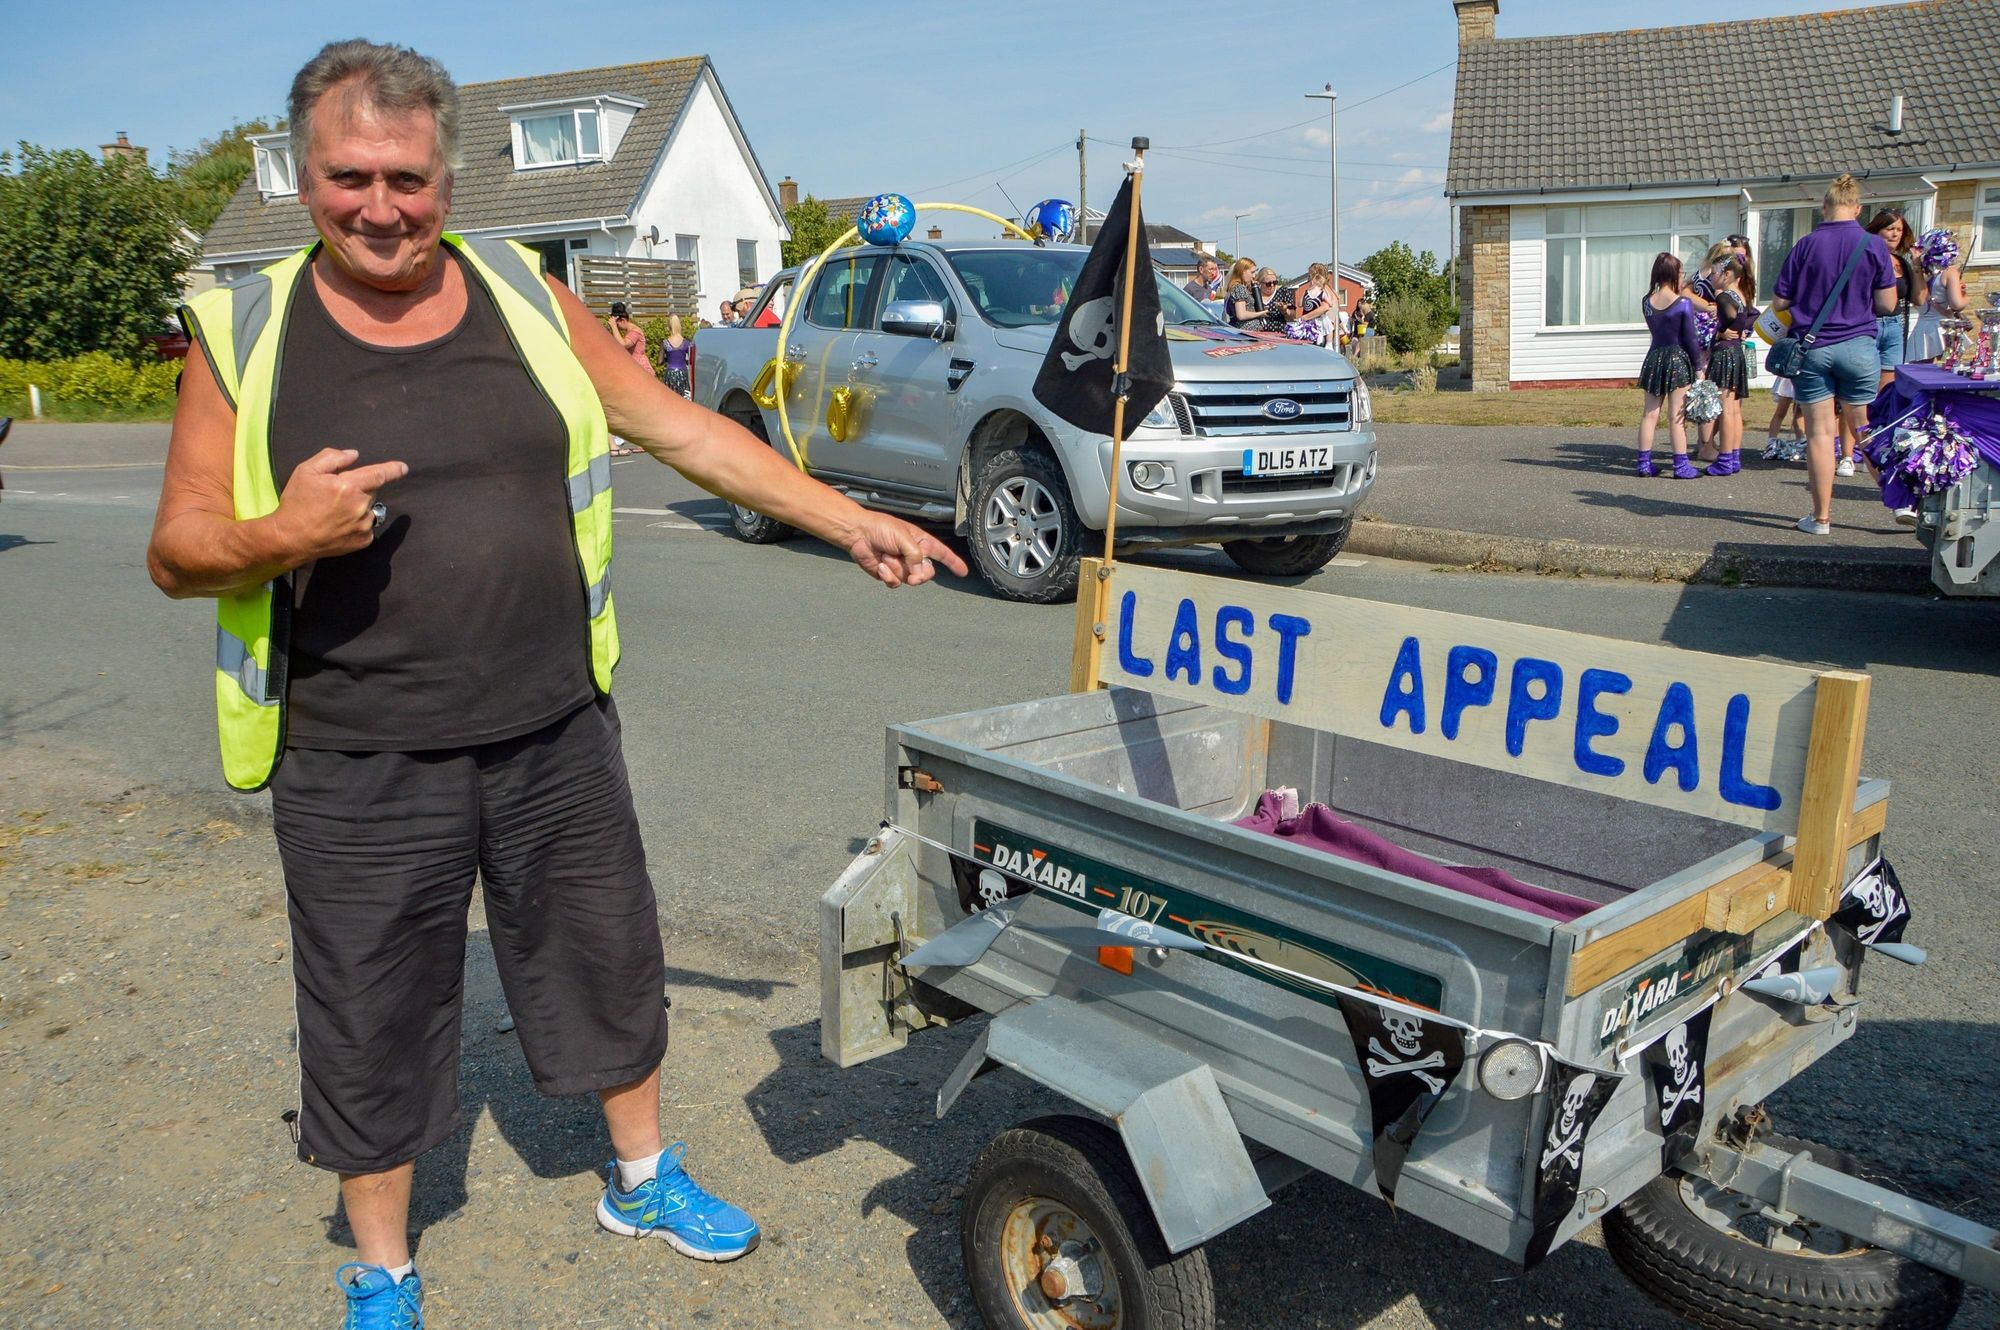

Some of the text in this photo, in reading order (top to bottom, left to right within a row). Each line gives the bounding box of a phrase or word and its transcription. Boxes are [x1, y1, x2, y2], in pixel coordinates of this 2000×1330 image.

[1274, 401, 1296, 414] Ford
[1258, 447, 1328, 471] DL15 ATZ
[1118, 590, 1782, 811] LAST APPEAL
[992, 844, 1168, 925] DAXARA 107
[1602, 971, 1678, 1038] DAXARA
